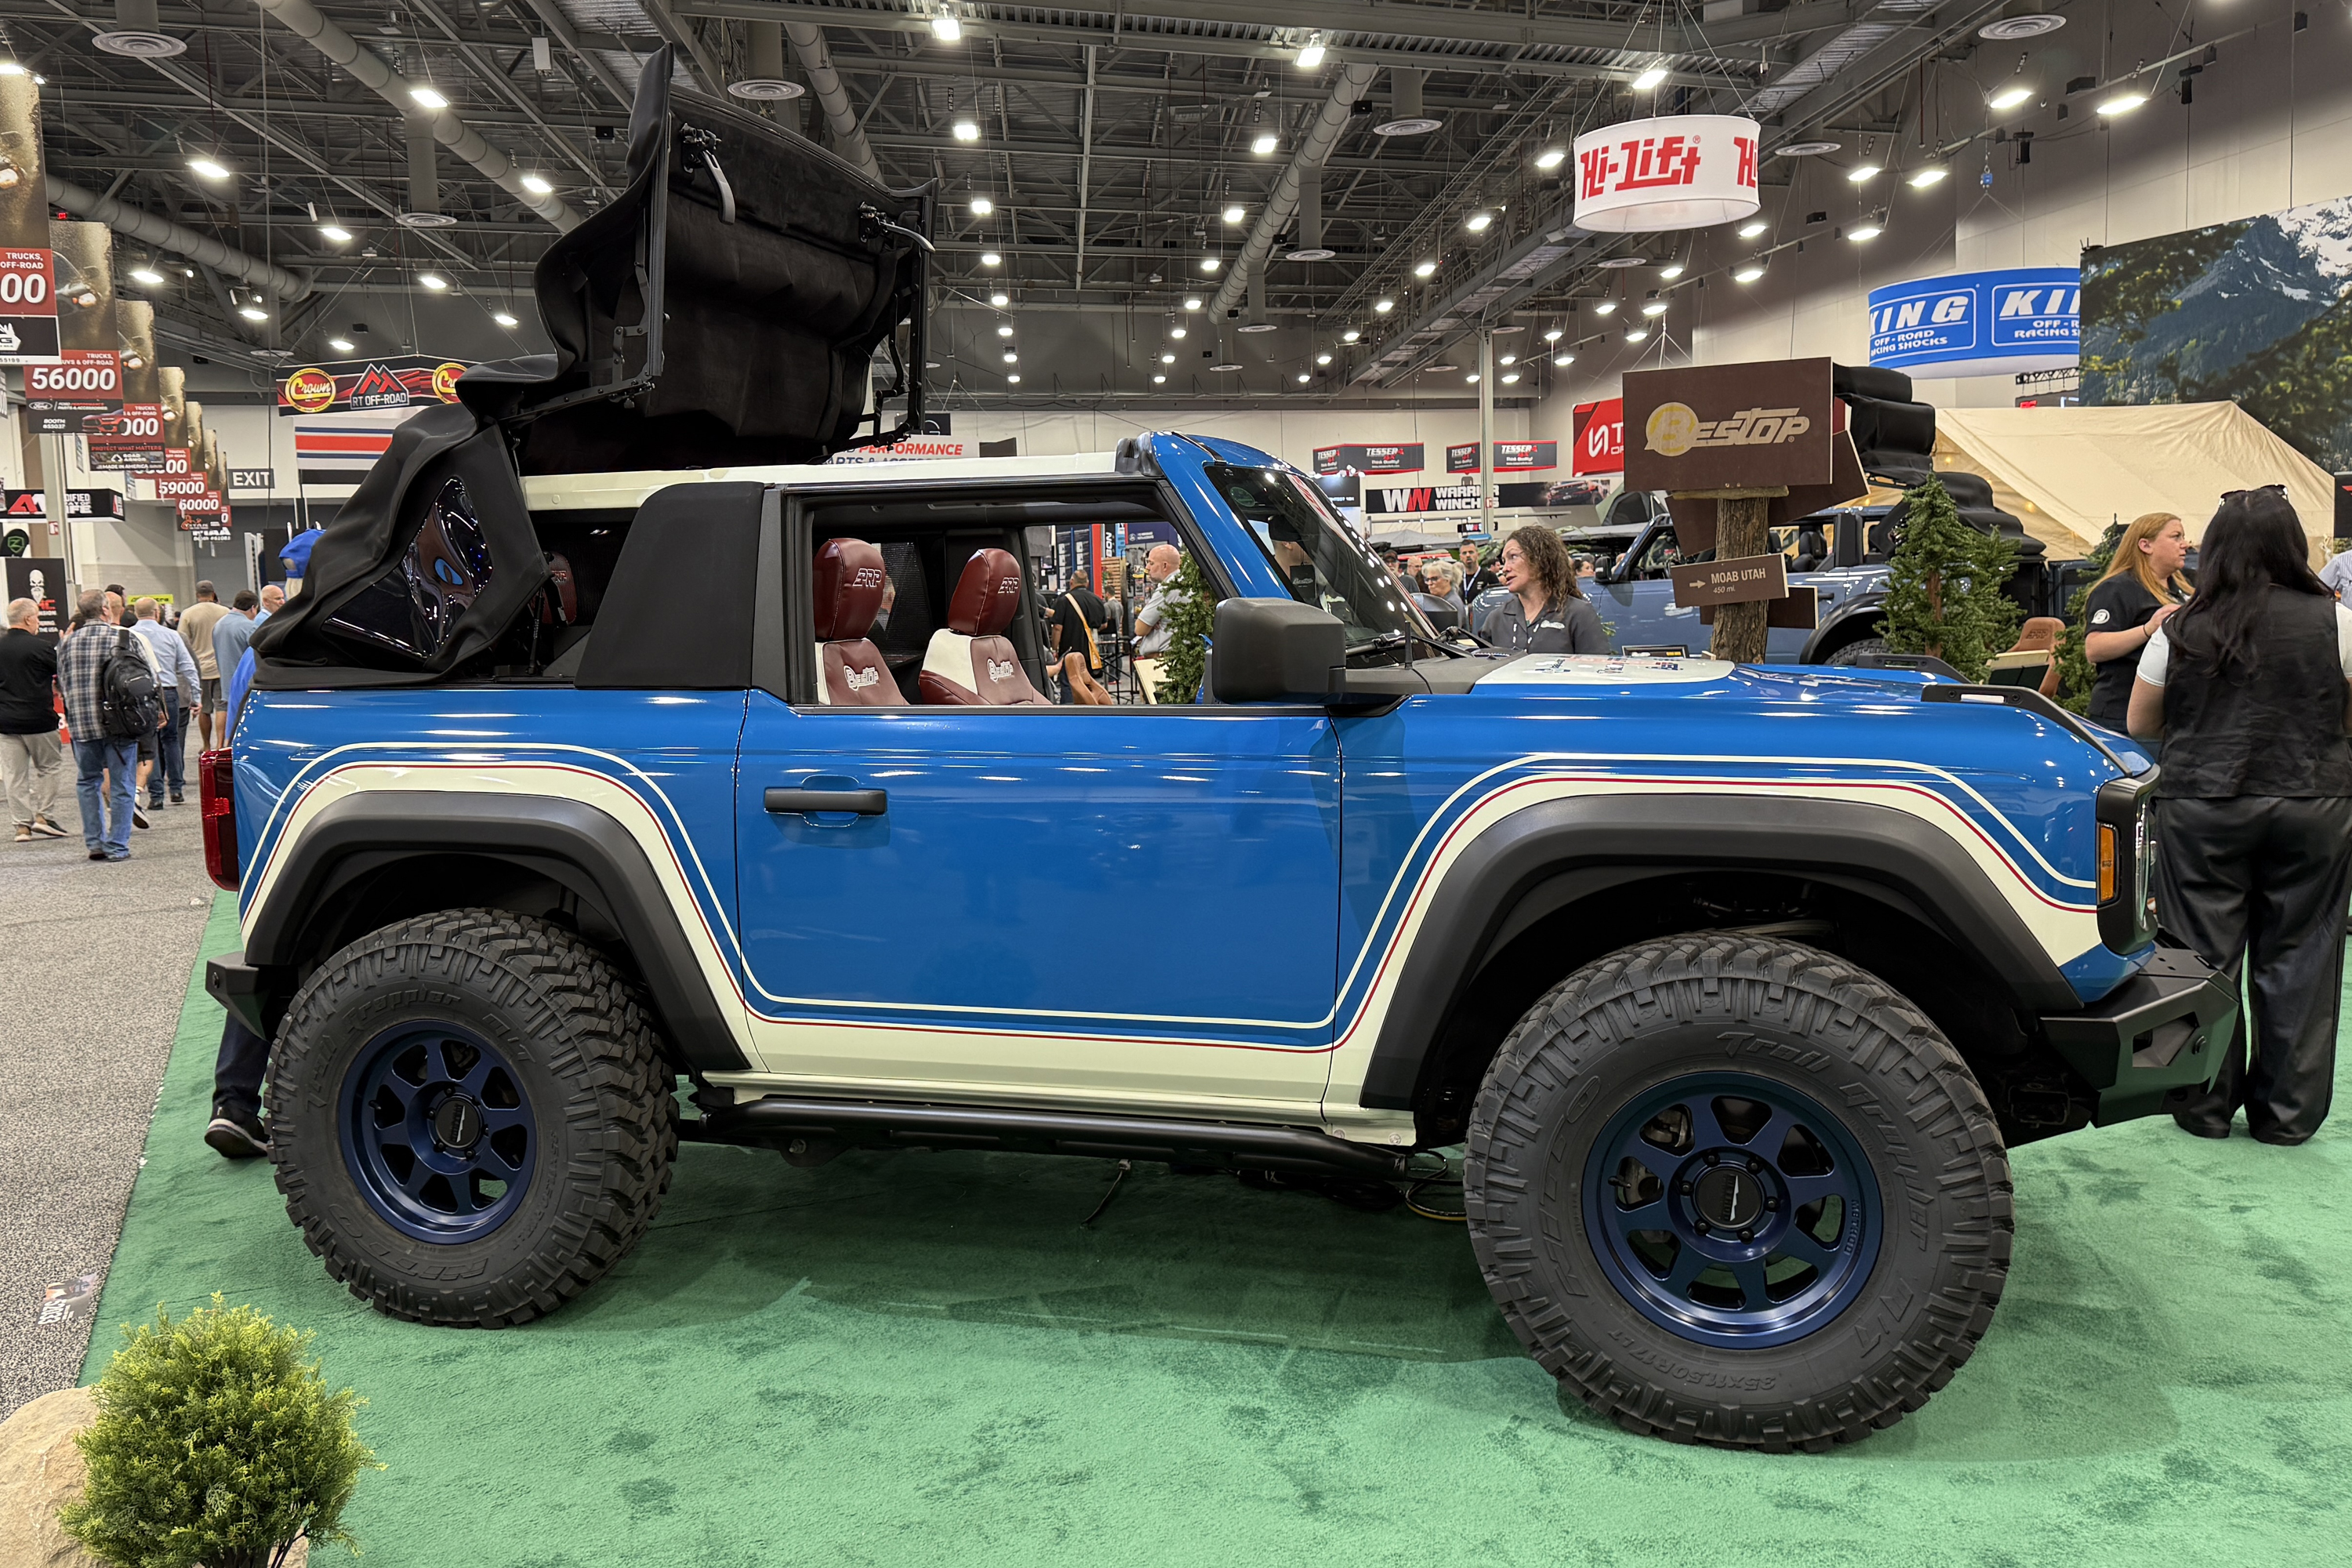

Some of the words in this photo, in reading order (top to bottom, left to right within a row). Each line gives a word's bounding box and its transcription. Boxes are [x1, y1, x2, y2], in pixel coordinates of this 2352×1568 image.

[5, 252, 43, 261] TRUCKS,
[2014, 329, 2069, 338] RACING
[1898, 336, 1948, 350] SHOCKS
[31, 368, 116, 390] 56000
[292, 376, 332, 401] Crown
[353, 396, 364, 406] RT
[365, 394, 407, 406] OFF-ROAD
[232, 472, 270, 486] EXIT
[158, 481, 205, 494] 59000
[1435, 485, 1499, 499] WARRIR
[179, 499, 220, 510] 60000
[1435, 496, 1499, 510] WINCHS
[1711, 571, 1740, 584] MOAB
[1740, 568, 1766, 581] UTAH
